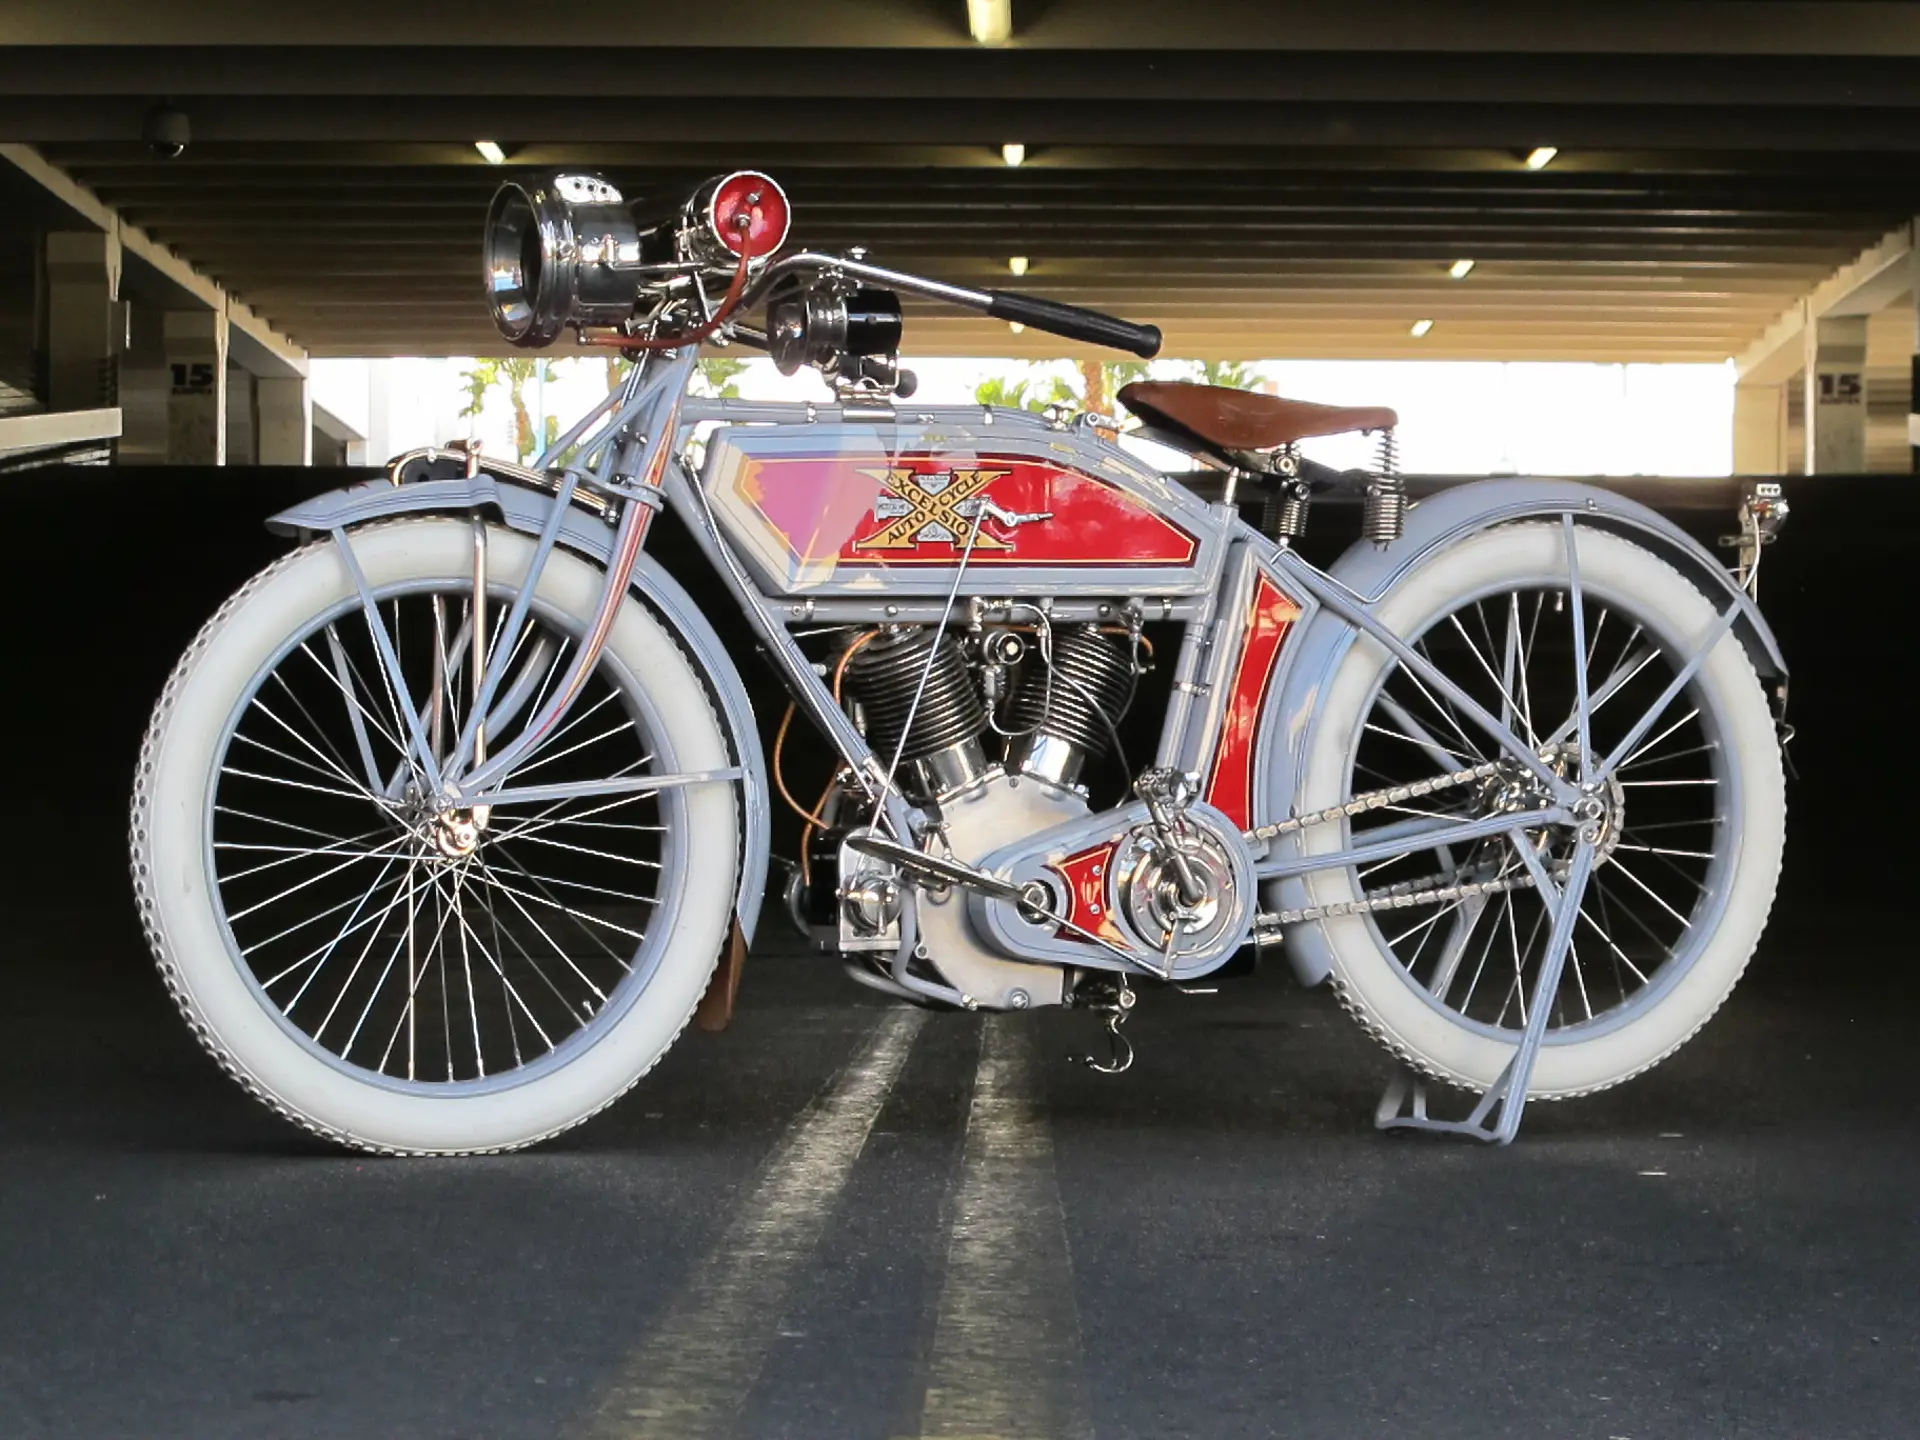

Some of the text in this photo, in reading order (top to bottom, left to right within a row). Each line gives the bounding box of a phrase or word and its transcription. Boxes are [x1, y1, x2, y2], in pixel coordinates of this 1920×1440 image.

[171, 363, 214, 387] 15
[1818, 374, 1861, 396] 15
[888, 471, 983, 544] AUTO CYCLE
